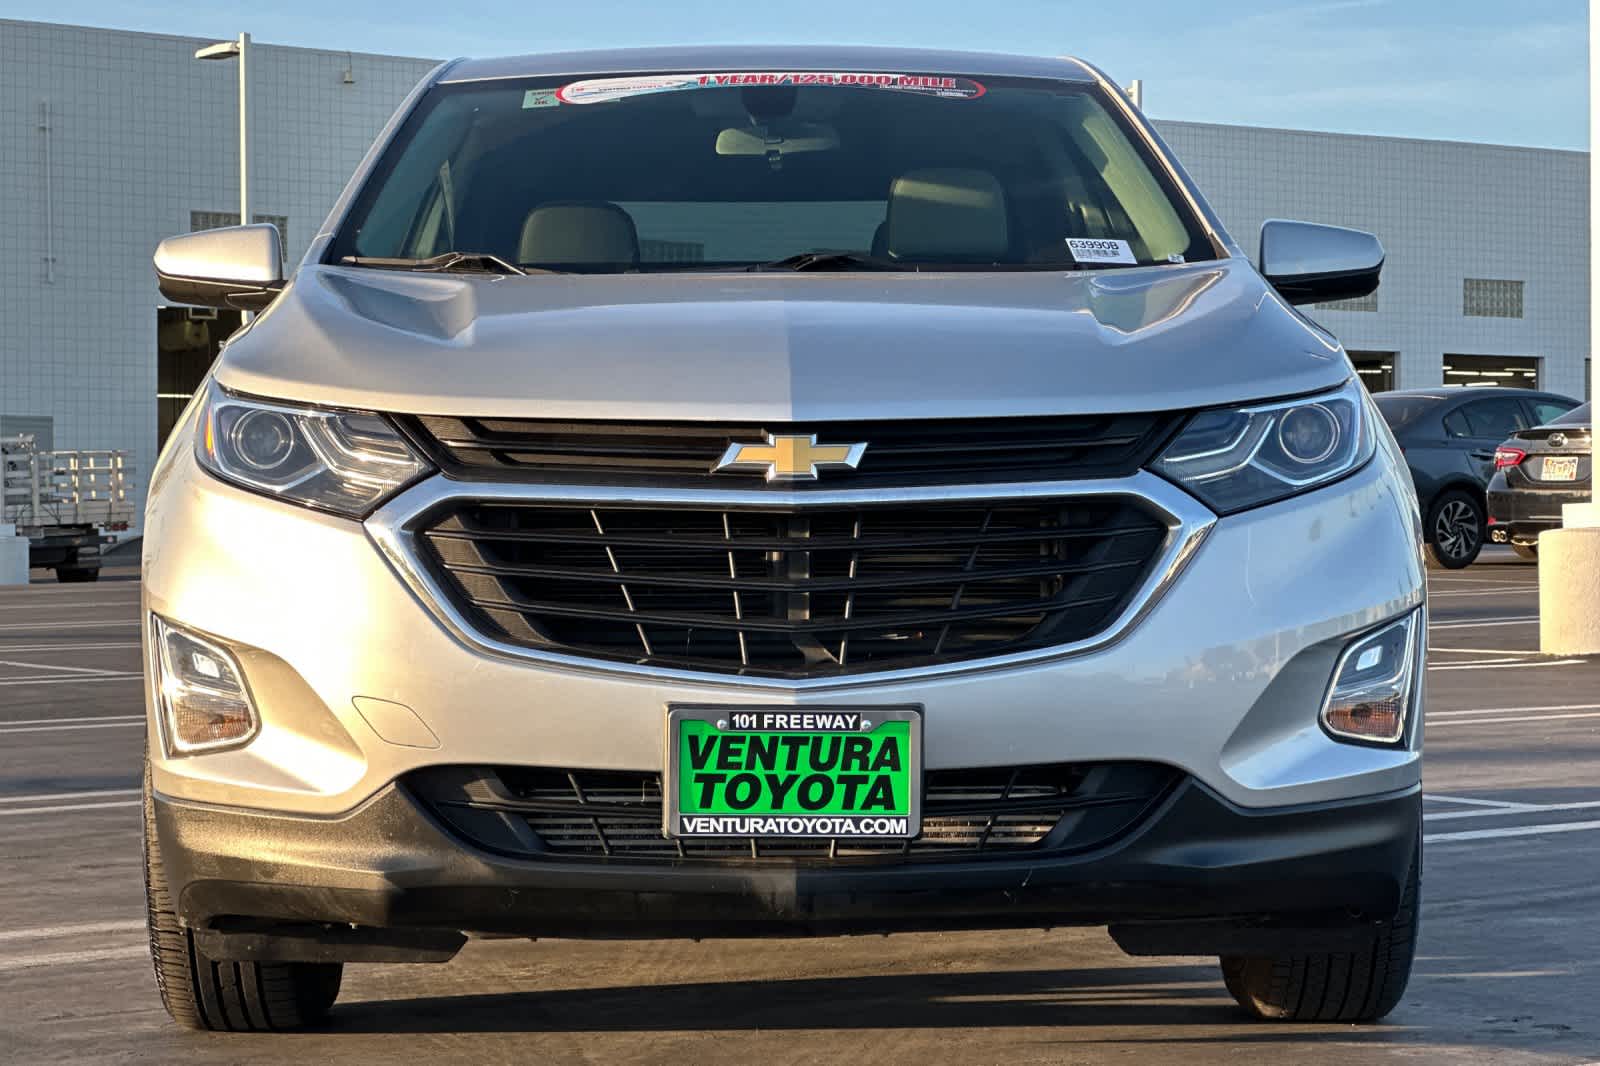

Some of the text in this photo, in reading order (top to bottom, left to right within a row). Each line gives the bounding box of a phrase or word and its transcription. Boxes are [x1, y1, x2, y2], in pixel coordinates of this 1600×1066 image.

[697, 74, 956, 88] 1 YEAR/125,000 MILE
[1069, 240, 1119, 250] 63990B
[732, 714, 857, 729] 101 FREEWAY
[688, 735, 901, 772] VENTURA
[694, 773, 896, 810] TOYOTA
[682, 818, 907, 834] VENTURATOYOTA.COM
